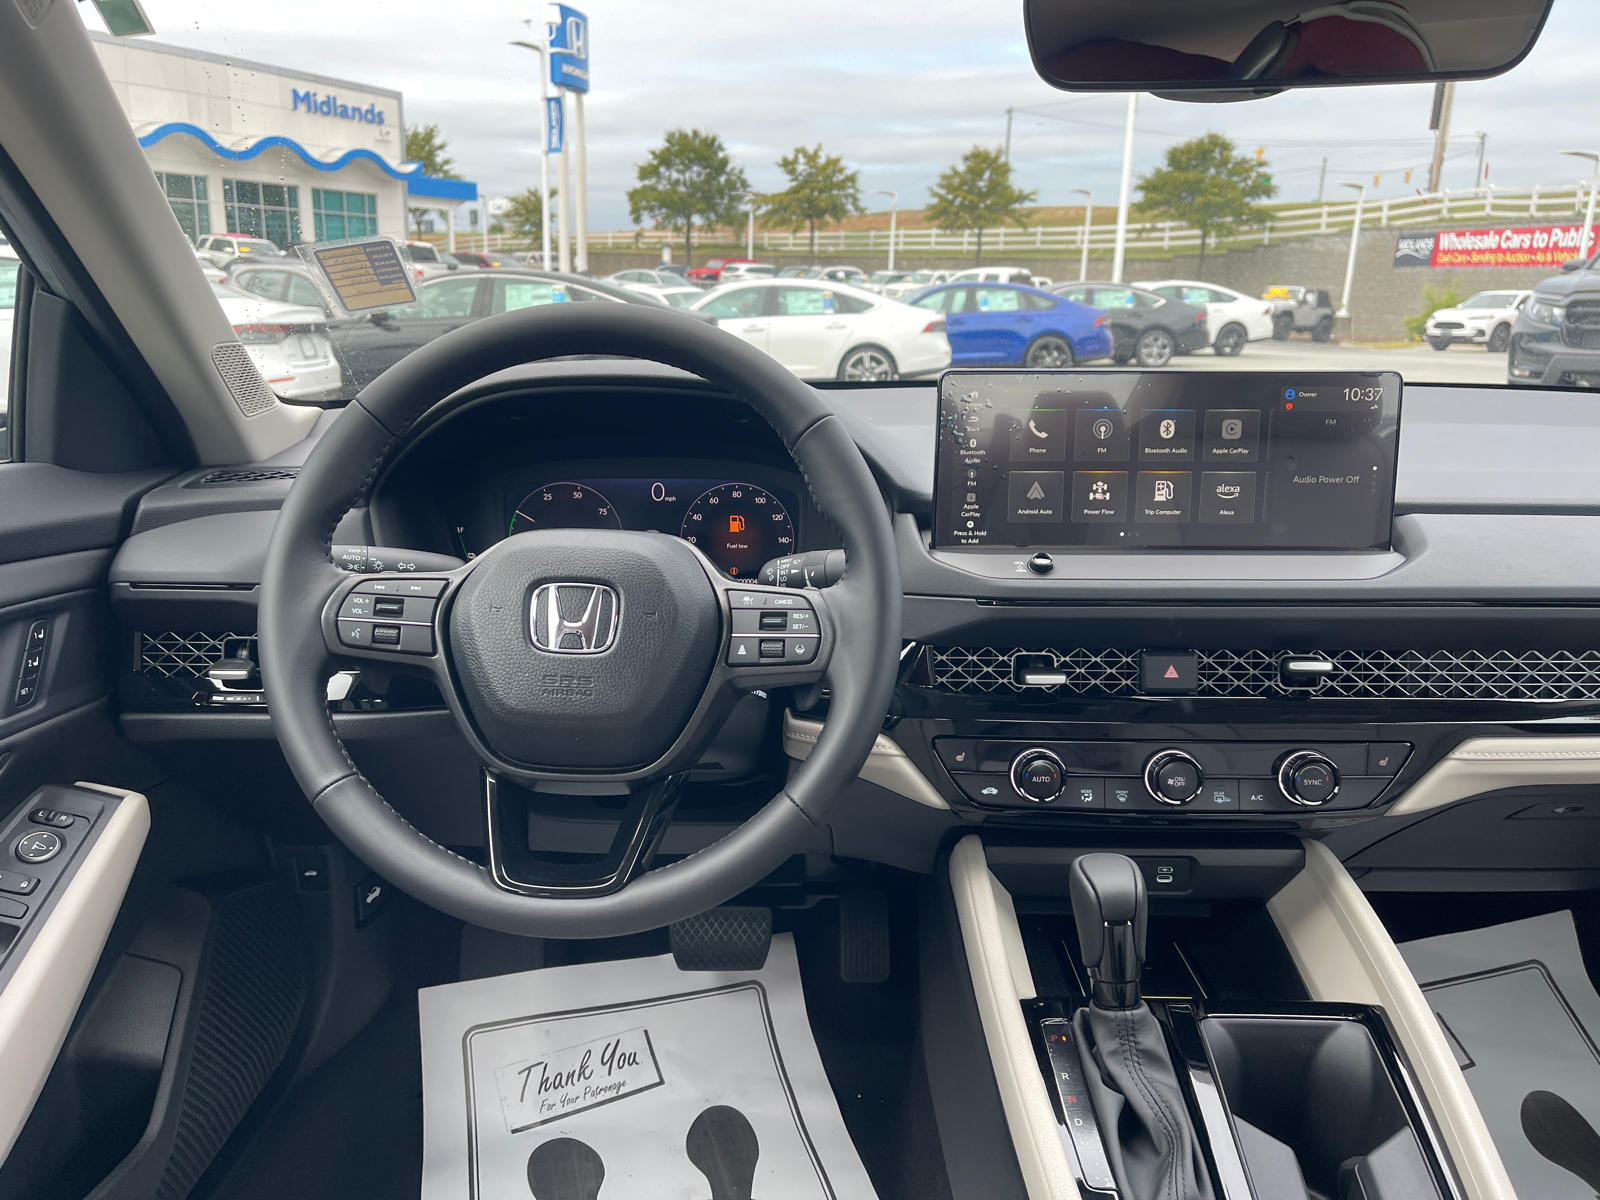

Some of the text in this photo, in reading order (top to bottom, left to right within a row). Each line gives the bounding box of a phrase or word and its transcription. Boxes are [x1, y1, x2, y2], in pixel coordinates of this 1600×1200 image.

[292, 88, 384, 125] Midlands
[1439, 227, 1595, 250] Wholesale Cars to Publc
[1437, 252, 1451, 263] Cash
[1452, 252, 1466, 263] Cars
[1471, 252, 1497, 265] Sending
[1505, 251, 1531, 263] Auction
[1343, 387, 1384, 402] 10:37
[1325, 418, 1337, 426] FM
[1212, 447, 1250, 455] Apple CarPlay
[1293, 474, 1360, 484] Audio Power Off
[1216, 483, 1240, 493] alexa
[573, 491, 583, 500] 50
[651, 482, 677, 503] 0 mph
[732, 490, 742, 498] 80
[543, 493, 553, 501] 25
[709, 496, 719, 504] 60
[754, 496, 766, 504] 100
[598, 508, 608, 516] 75
[1144, 508, 1182, 516] Trip Computer
[692, 513, 703, 521] 40
[771, 513, 784, 521] 120
[778, 536, 790, 544] 140
[20, 687, 29, 696] SET
[1303, 778, 1323, 786] SYNC
[518, 1038, 639, 1103] Thank You
[1062, 1072, 1069, 1080] R
[539, 1079, 627, 1114] For Your Patronage
[1067, 1095, 1076, 1103] N
[1074, 1118, 1083, 1126] D
